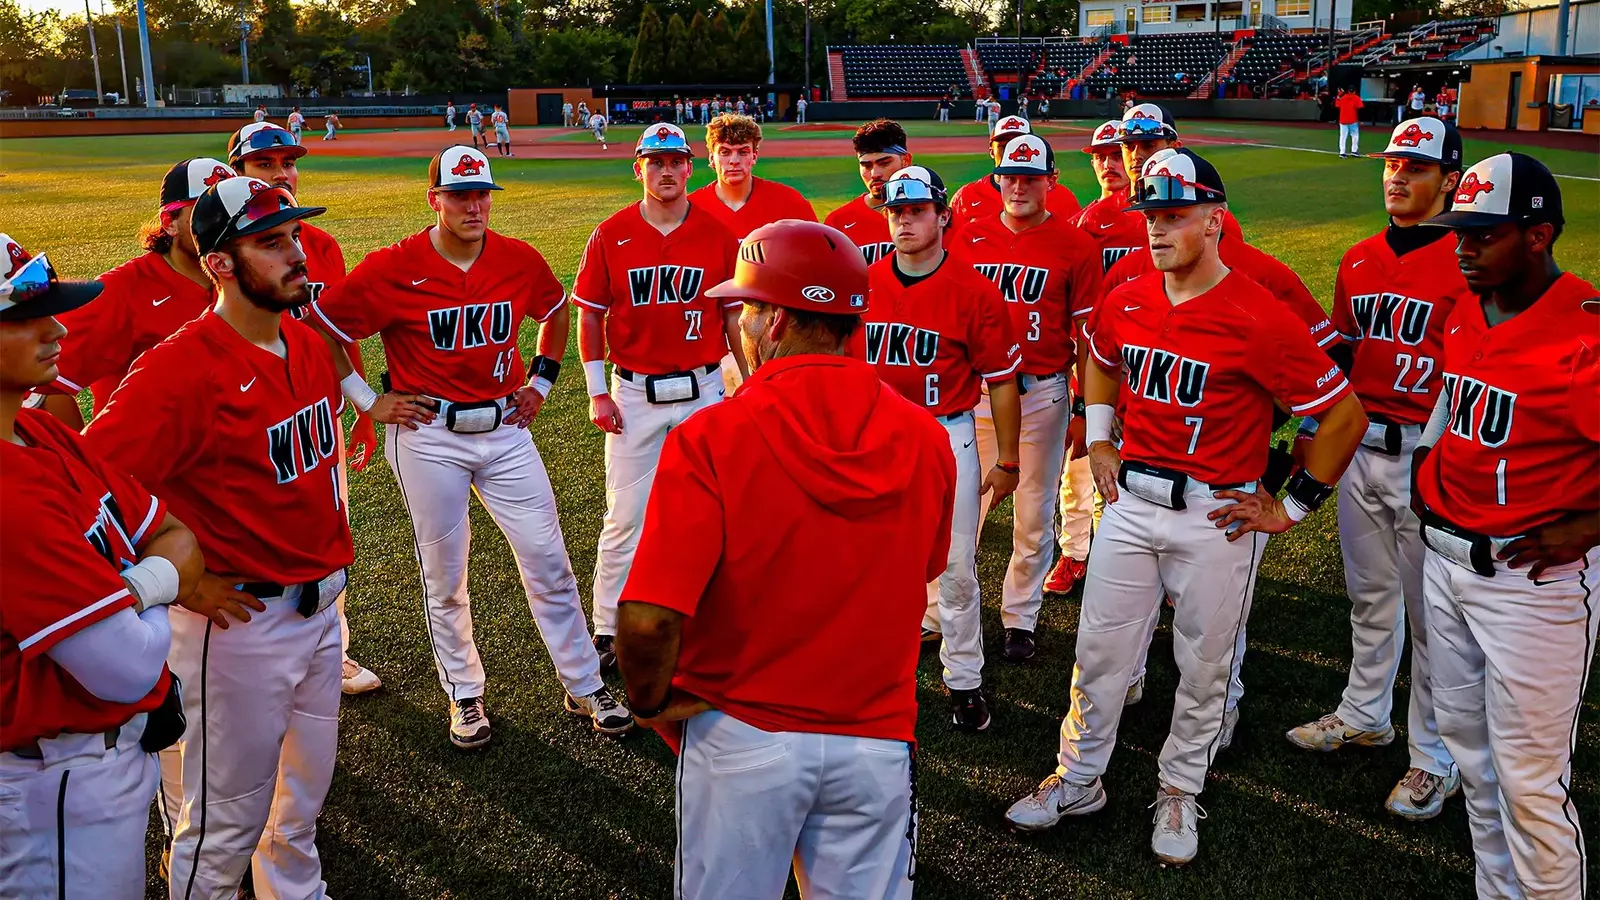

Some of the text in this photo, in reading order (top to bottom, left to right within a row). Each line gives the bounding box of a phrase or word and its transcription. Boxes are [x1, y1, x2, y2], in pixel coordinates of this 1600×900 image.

[627, 264, 704, 307] WKU
[427, 301, 512, 350] WKU
[684, 310, 703, 340] 27
[1027, 311, 1041, 341] 3
[1351, 292, 1434, 346] WKU
[865, 322, 940, 367] WKU
[925, 373, 939, 406] 6
[1121, 343, 1211, 408] WKU
[1393, 353, 1435, 393] 22
[266, 396, 336, 484] WKU
[1185, 416, 1203, 455] 7
[1495, 459, 1507, 505] 1
